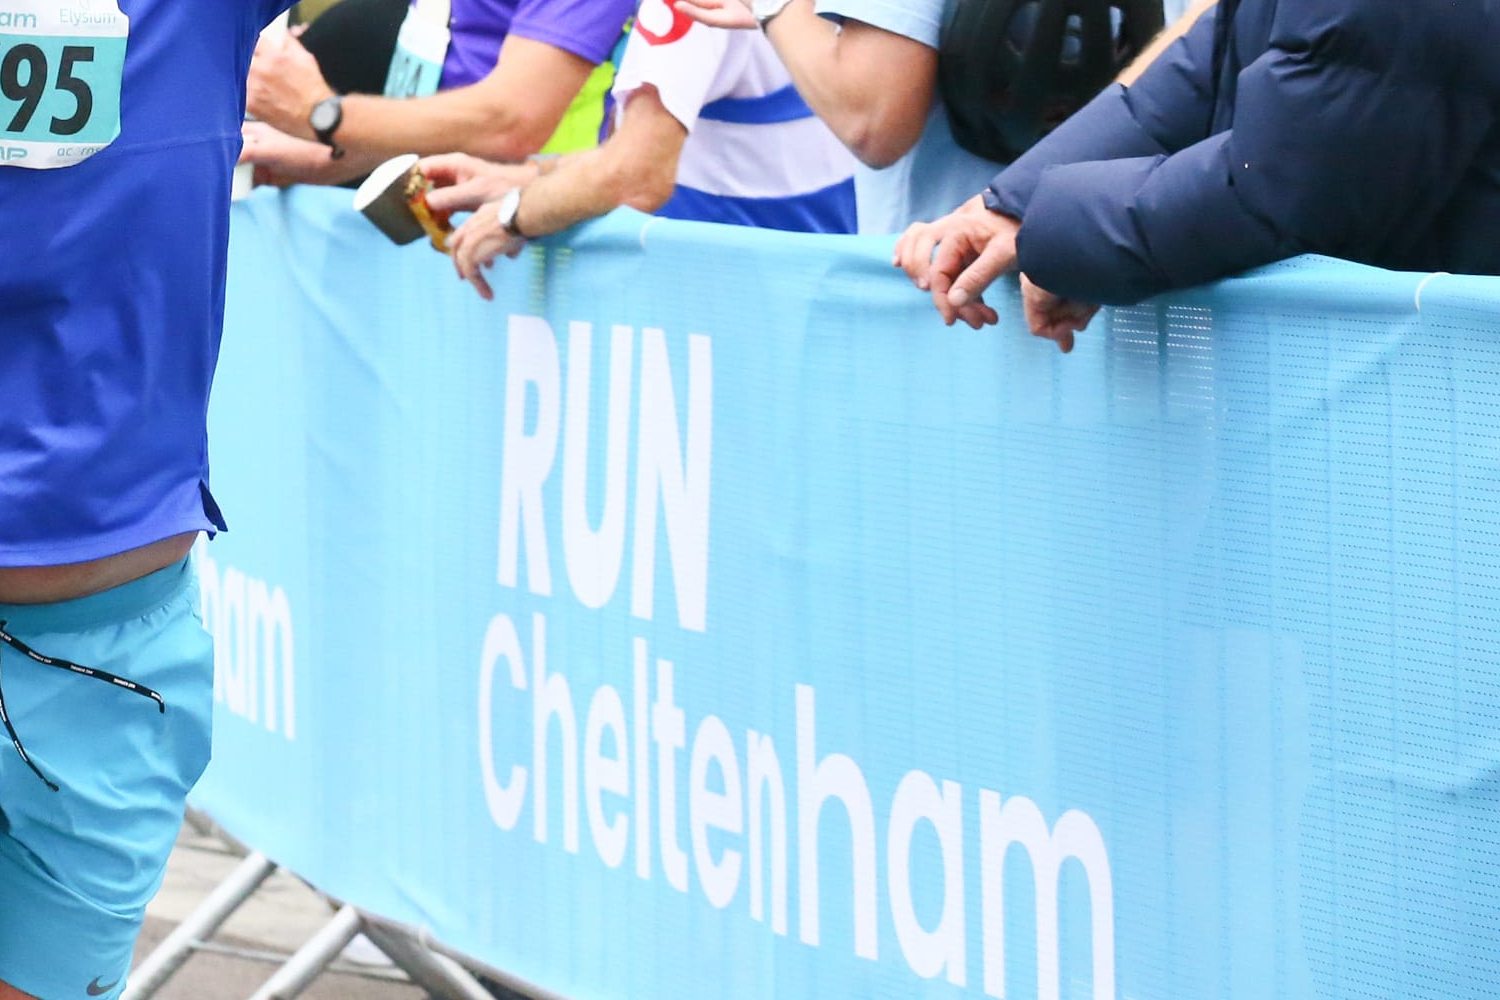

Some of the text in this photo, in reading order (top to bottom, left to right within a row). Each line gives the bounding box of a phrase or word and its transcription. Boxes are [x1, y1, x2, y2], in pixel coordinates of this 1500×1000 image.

[60, 7, 117, 27] Elysium
[497, 314, 712, 633] RUN
[477, 612, 1115, 1000] Cheltenham
